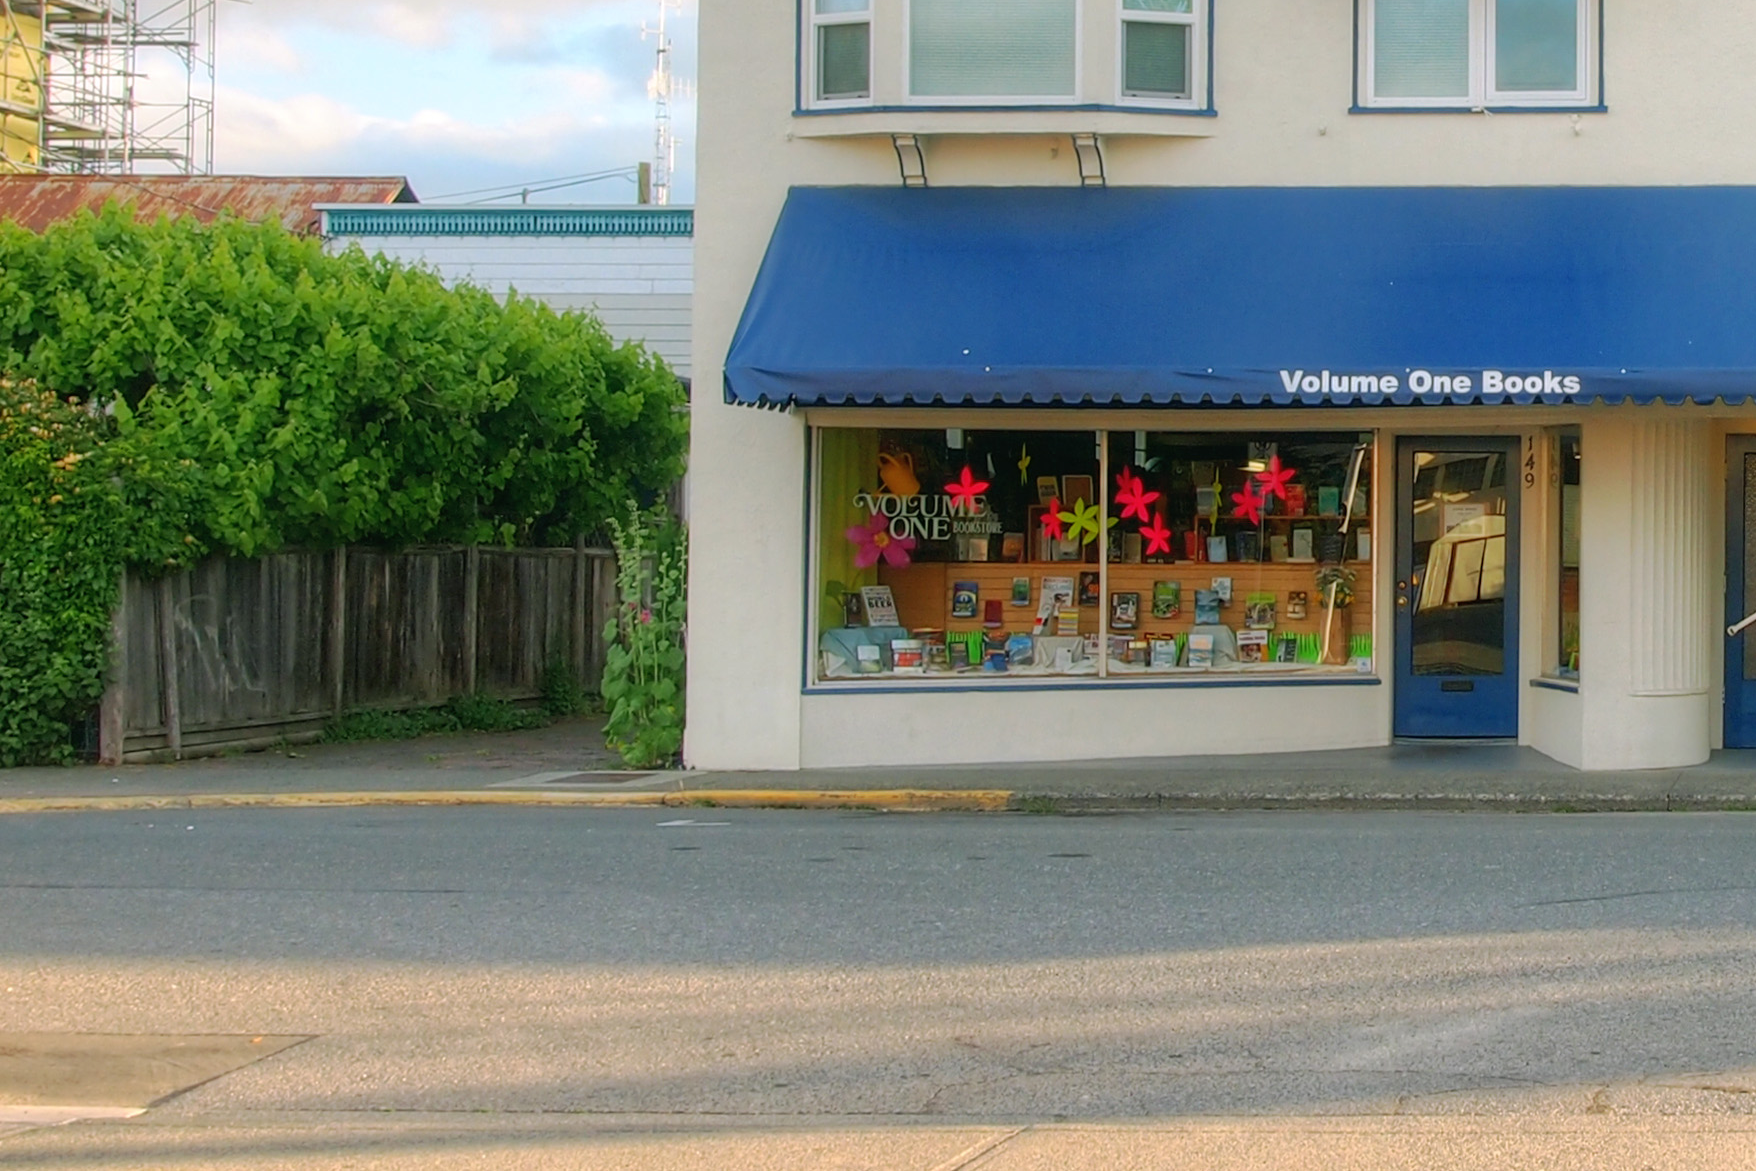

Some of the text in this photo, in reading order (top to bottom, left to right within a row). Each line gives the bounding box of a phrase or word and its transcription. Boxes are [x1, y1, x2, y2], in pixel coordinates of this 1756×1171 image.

[1279, 369, 1581, 394] Volume One Books
[1524, 435, 1536, 490] 149
[852, 493, 988, 517] VOLUME
[889, 517, 1004, 541] ONE BOOKSTORE
